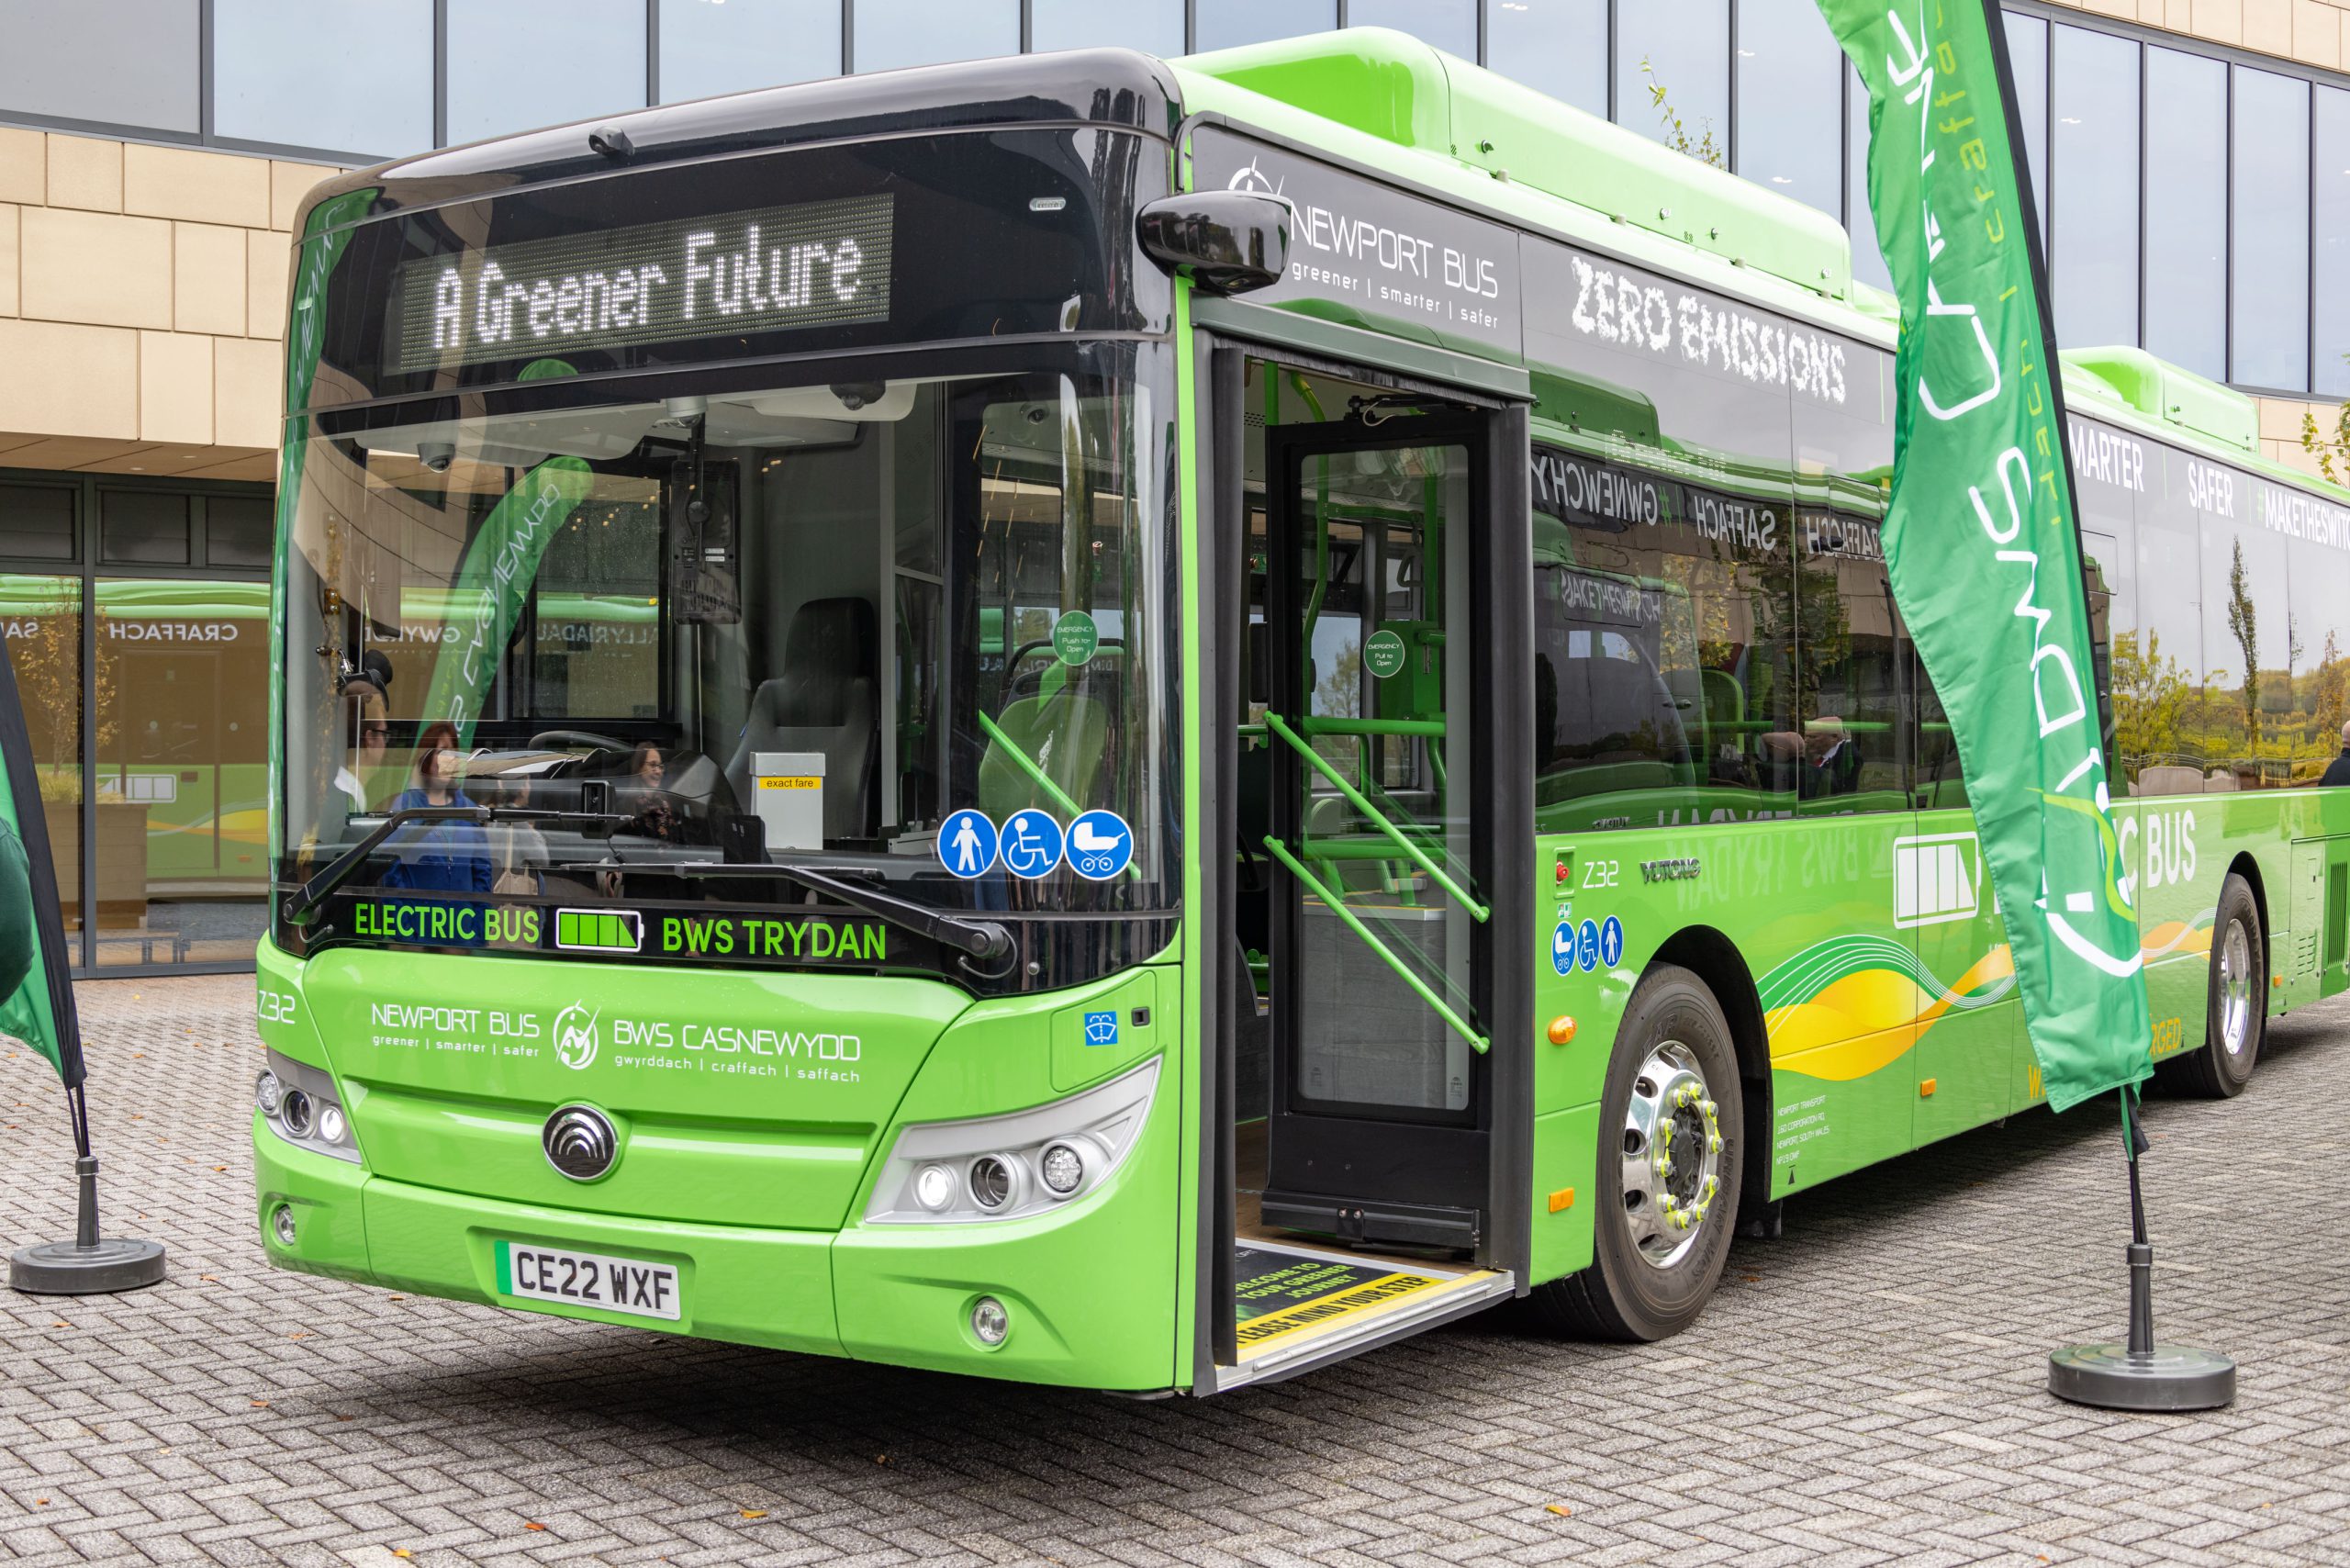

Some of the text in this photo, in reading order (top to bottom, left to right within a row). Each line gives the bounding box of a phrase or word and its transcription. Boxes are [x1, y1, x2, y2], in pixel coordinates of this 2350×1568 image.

[1291, 200, 1498, 298] NEWPORT BUS
[434, 225, 863, 349] A Greener Future
[1292, 262, 1498, 329] greener smarter safer
[1571, 256, 1847, 405] ZERO EMISSIONS
[2067, 421, 2145, 493] MARTER
[2188, 461, 2234, 519] SAFER
[1067, 645, 1084, 654] Open
[767, 778, 814, 788] exact fare
[2147, 809, 2197, 889] BUS
[1583, 860, 1619, 889] Z32
[1639, 857, 1700, 884] YUTONG
[355, 902, 540, 943] ELECTRIC BUS
[663, 917, 886, 960] BWS TRYDAN
[258, 990, 296, 1025] Z32
[371, 1003, 540, 1037] NEWPORT BUS
[373, 1035, 540, 1058] greener smarter safer
[614, 1020, 860, 1061] BWS CASNEWYDD
[2149, 1017, 2182, 1057] RGED
[615, 1055, 860, 1082] gwyrddach craffach saffach
[1777, 1094, 1826, 1116] NEWPORT TRANSPORT
[1787, 1114, 1817, 1131] CORPORATION
[1799, 1130, 1814, 1142] SOUTH
[517, 1251, 672, 1309] CE22 WXF
[1236, 1264, 1355, 1299] YOUR GREENER
[1291, 1262, 1321, 1271] TO
[1282, 1304, 1348, 1324] MIND
[1328, 1289, 1395, 1307] YOUR
[1375, 1276, 1430, 1293] STEP
[1285, 1274, 1358, 1298] JOURNEY
